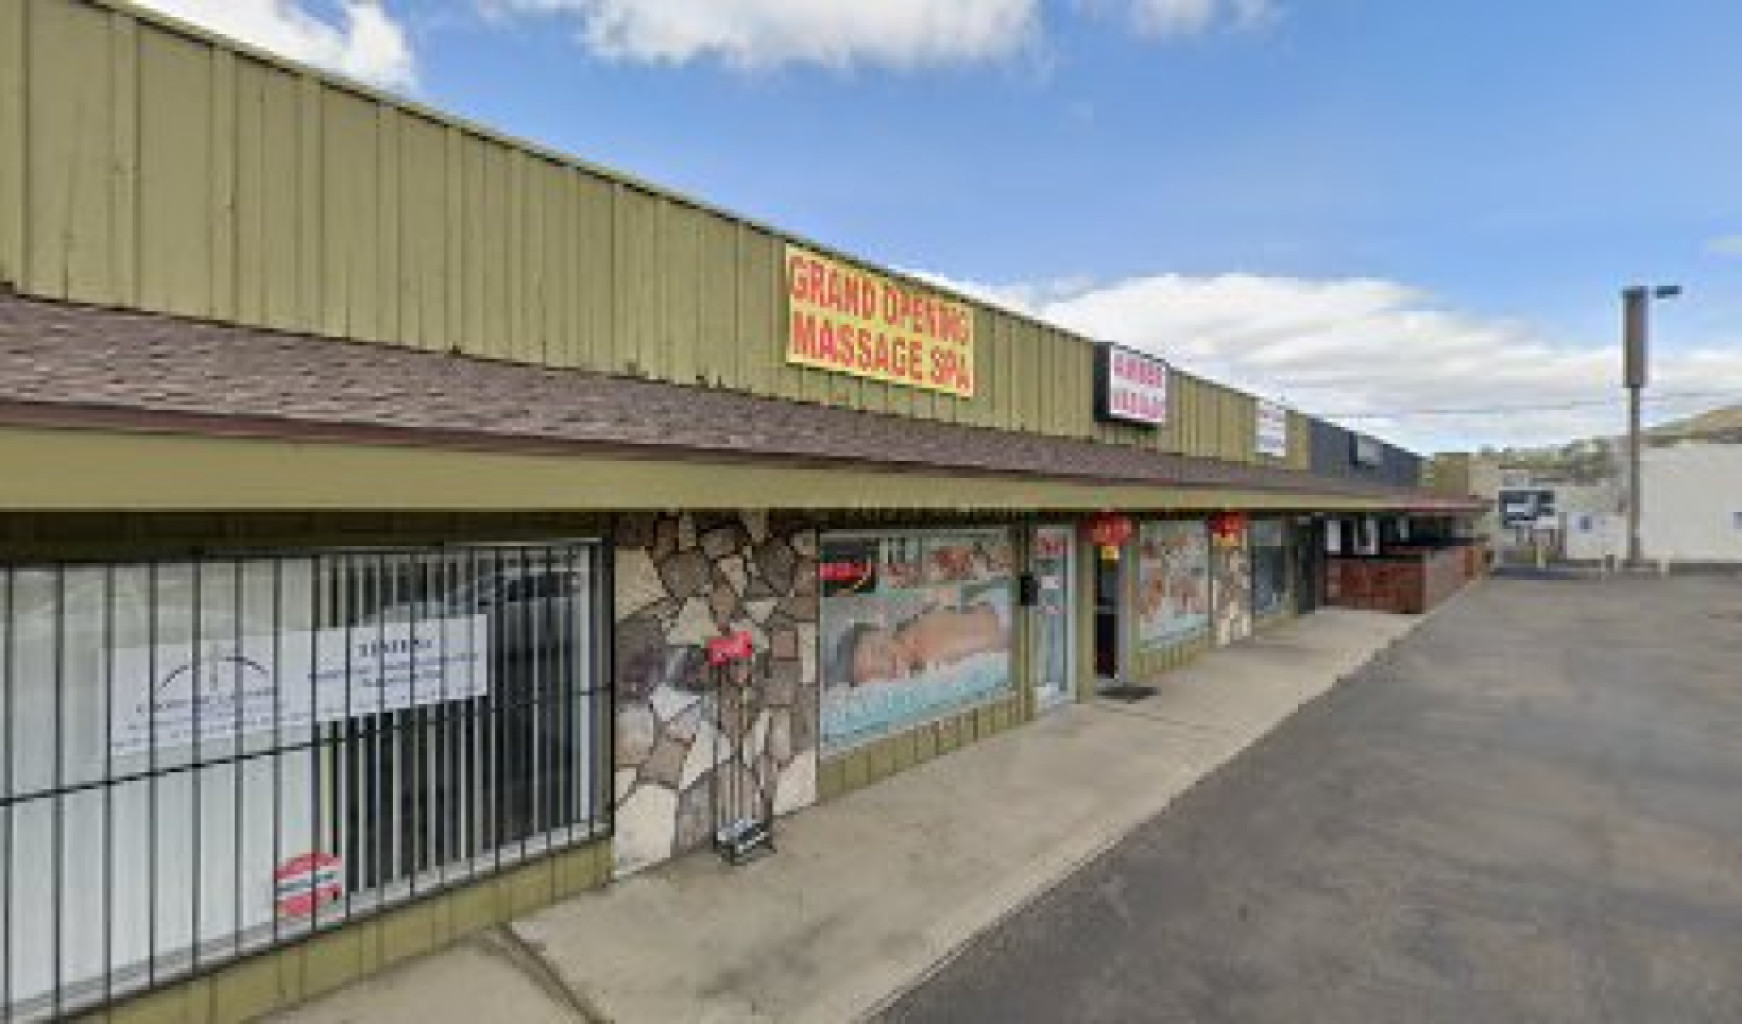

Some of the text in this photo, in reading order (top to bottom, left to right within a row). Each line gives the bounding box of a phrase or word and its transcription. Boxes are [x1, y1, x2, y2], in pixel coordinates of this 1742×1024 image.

[789, 256, 970, 346] GRAND OPENING
[793, 310, 970, 389] MASSAGE SPA
